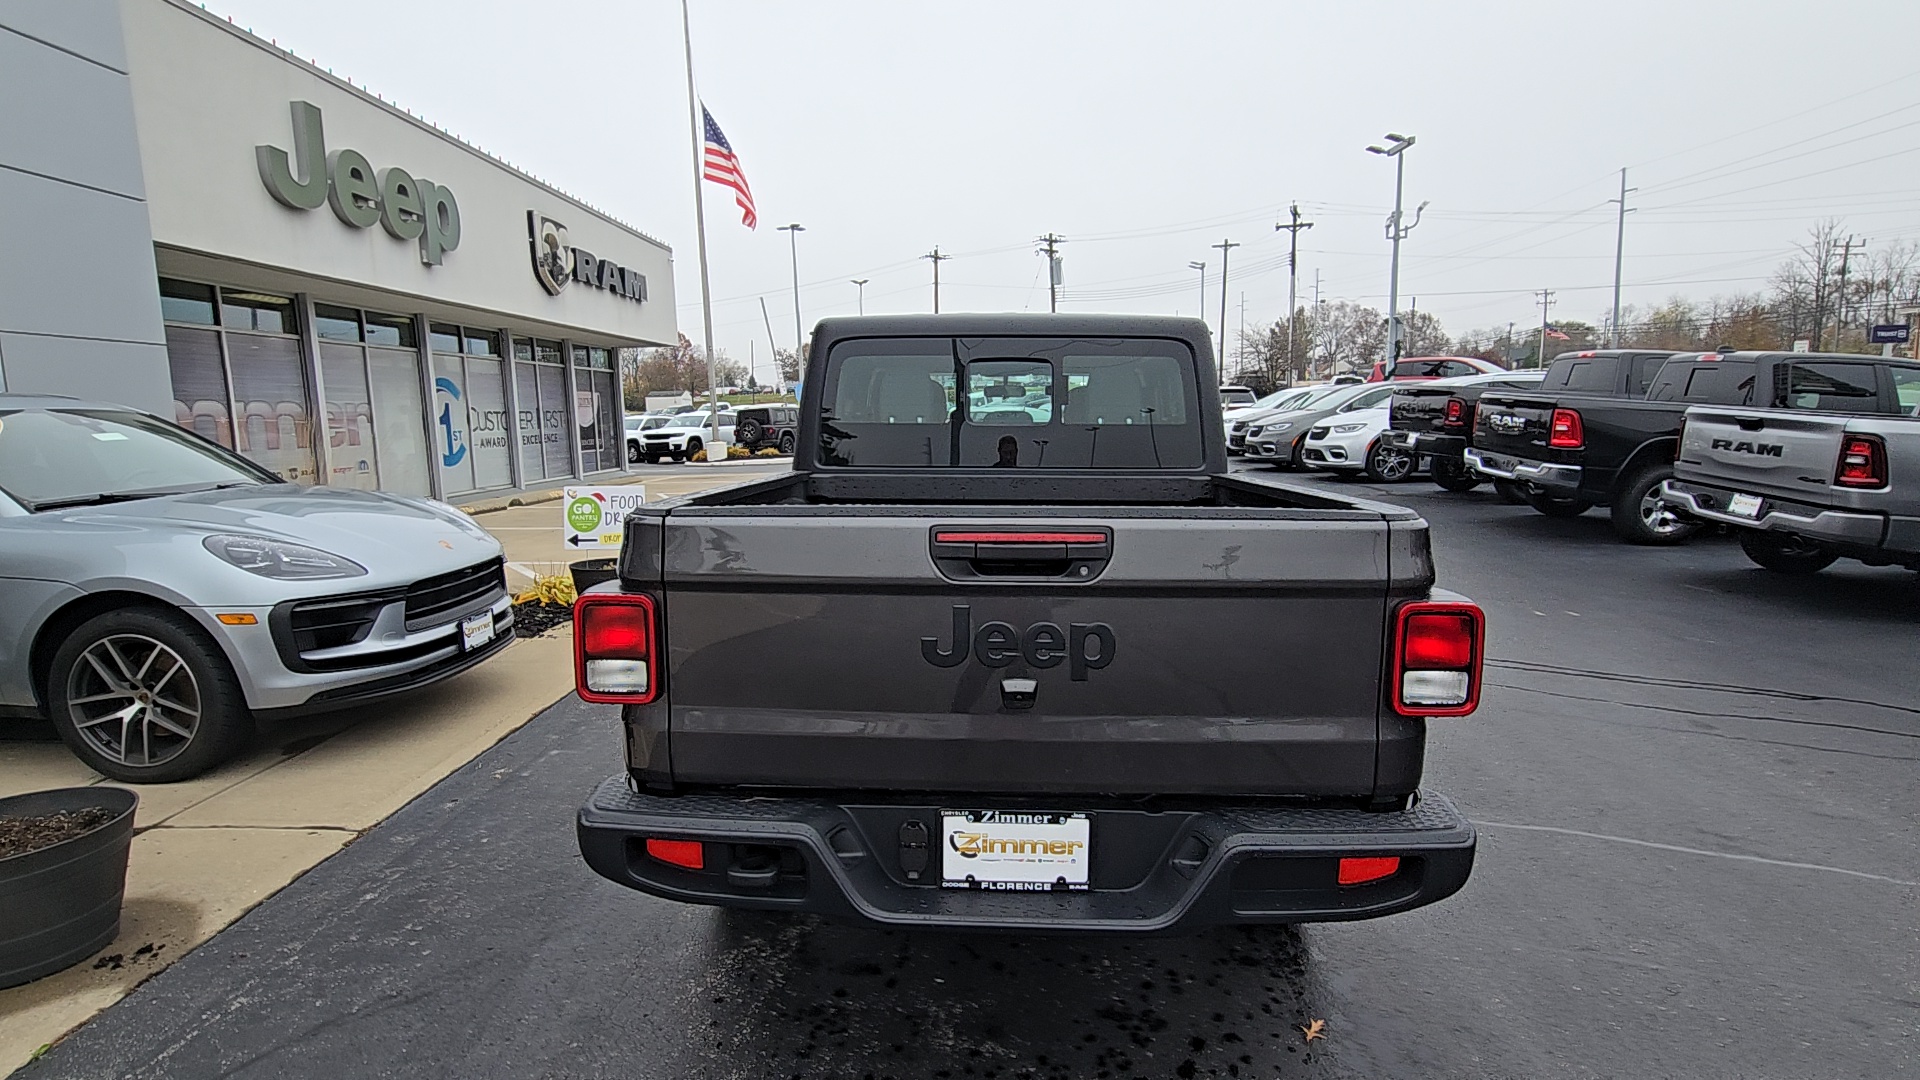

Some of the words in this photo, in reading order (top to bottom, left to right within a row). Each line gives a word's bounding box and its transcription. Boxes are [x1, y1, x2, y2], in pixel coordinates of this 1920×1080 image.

[255, 100, 462, 267] Jeep
[571, 247, 649, 303] RAM
[467, 406, 534, 433] CUSTOER
[1489, 414, 1526, 429] RAM
[480, 436, 506, 448] AWARD
[522, 433, 558, 446] EXCELENCE
[1711, 438, 1784, 458] RAM
[572, 502, 595, 515] GO!
[610, 494, 644, 510] FOOD
[920, 604, 1117, 682] Jeep
[980, 810, 1052, 824] Zimmer
[957, 832, 1084, 856] Zimmer
[980, 882, 1052, 891] FLORENCE
